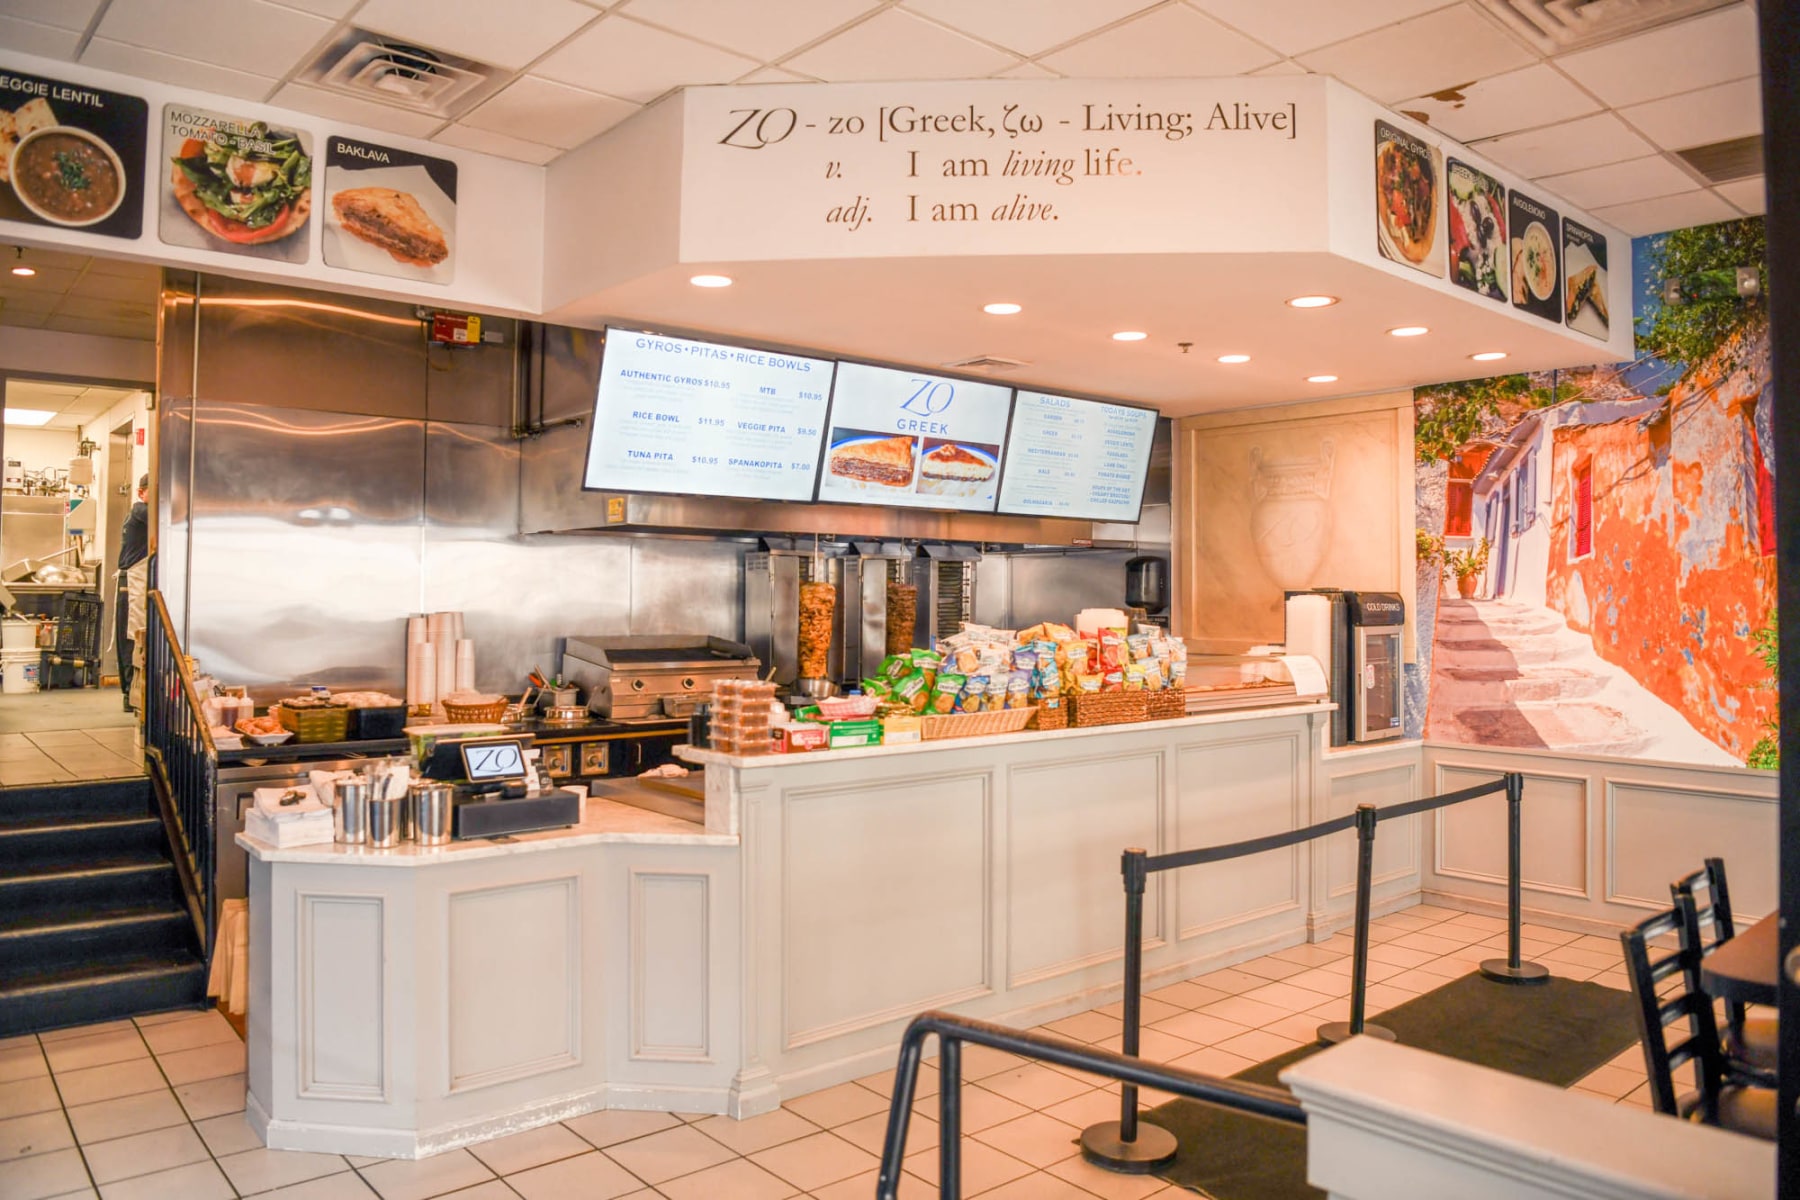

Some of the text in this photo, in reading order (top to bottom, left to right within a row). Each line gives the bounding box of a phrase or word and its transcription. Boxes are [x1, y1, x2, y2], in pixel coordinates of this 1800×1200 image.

[52, 86, 104, 108] LENTIL
[171, 111, 261, 138] MOZZARELLA
[716, 106, 799, 149] ZO
[828, 115, 865, 135] zo
[1082, 103, 1193, 140] Living;
[1204, 102, 1297, 139] Alive]
[171, 125, 228, 145] TOMATO
[237, 137, 277, 155] BASIL
[1381, 127, 1409, 150] ORIGINAL
[337, 143, 391, 164] BAKLAVA
[826, 148, 1143, 186] v. I am living life.
[826, 194, 1059, 231] adj. I am alive.
[635, 338, 811, 372] GYROS PITAS RICE BOWLS
[620, 369, 672, 383] AUTHENTIC
[673, 376, 703, 386] GYROS
[900, 378, 955, 417] ZO
[632, 411, 653, 421] RICE
[656, 413, 681, 423] BOWL
[737, 421, 766, 432] VEGGIE
[768, 425, 786, 433] PITA
[896, 418, 949, 435] GREEK
[627, 450, 719, 465] TUNA PITA $10.95
[728, 458, 783, 469] SPANAKOPITA
[1367, 602, 1381, 611] COLD
[474, 747, 518, 773] ZO
